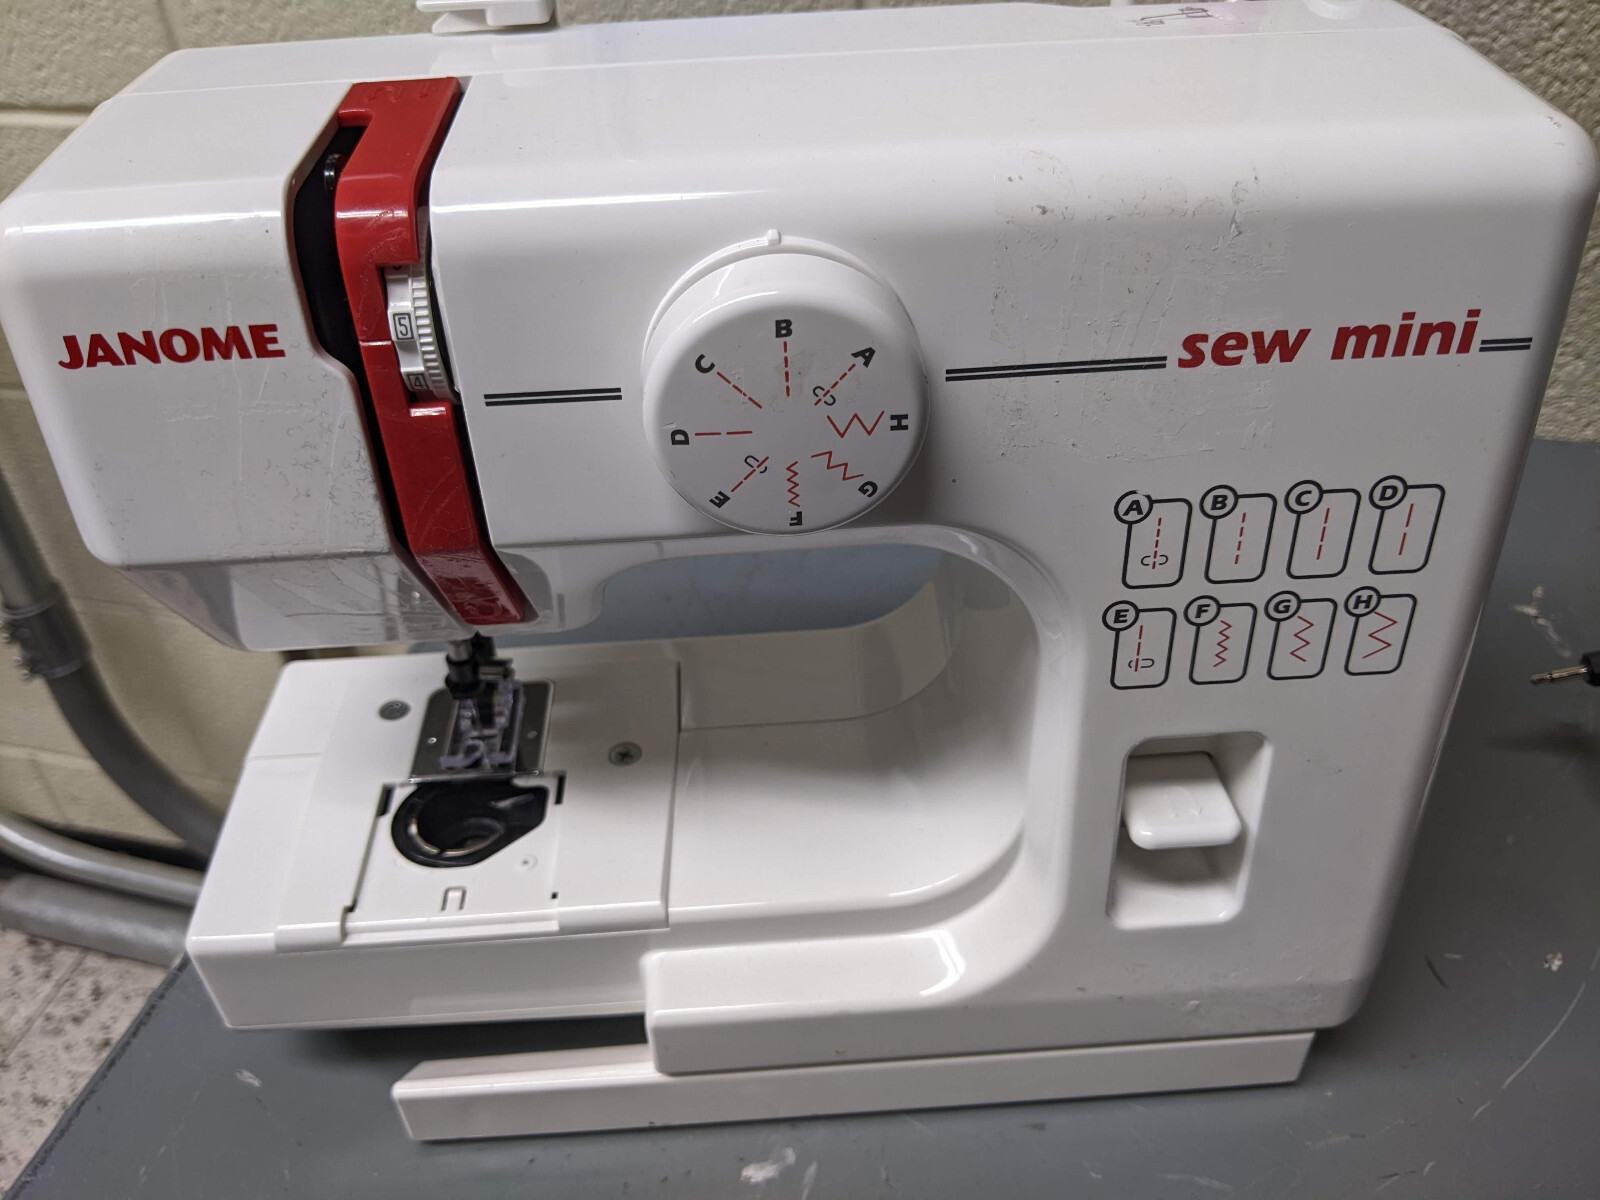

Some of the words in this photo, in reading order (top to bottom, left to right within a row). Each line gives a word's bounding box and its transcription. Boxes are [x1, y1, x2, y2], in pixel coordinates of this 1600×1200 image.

[774, 318, 793, 338] B
[57, 323, 287, 370] JANOME
[1178, 327, 1312, 369] sew
[1330, 308, 1482, 361] mini
[694, 354, 716, 375] C
[851, 346, 877, 368] A
[890, 413, 909, 431] H
[670, 429, 690, 446] D
[858, 480, 879, 498] G
[1378, 484, 1398, 502] D
[709, 490, 731, 509] E
[1209, 493, 1228, 511] B
[1295, 490, 1313, 507] C
[1121, 499, 1145, 517] A
[789, 511, 803, 527] F
[1195, 603, 1211, 619] F
[1273, 599, 1291, 614] G
[1352, 594, 1373, 610] H
[1112, 608, 1130, 625] E
